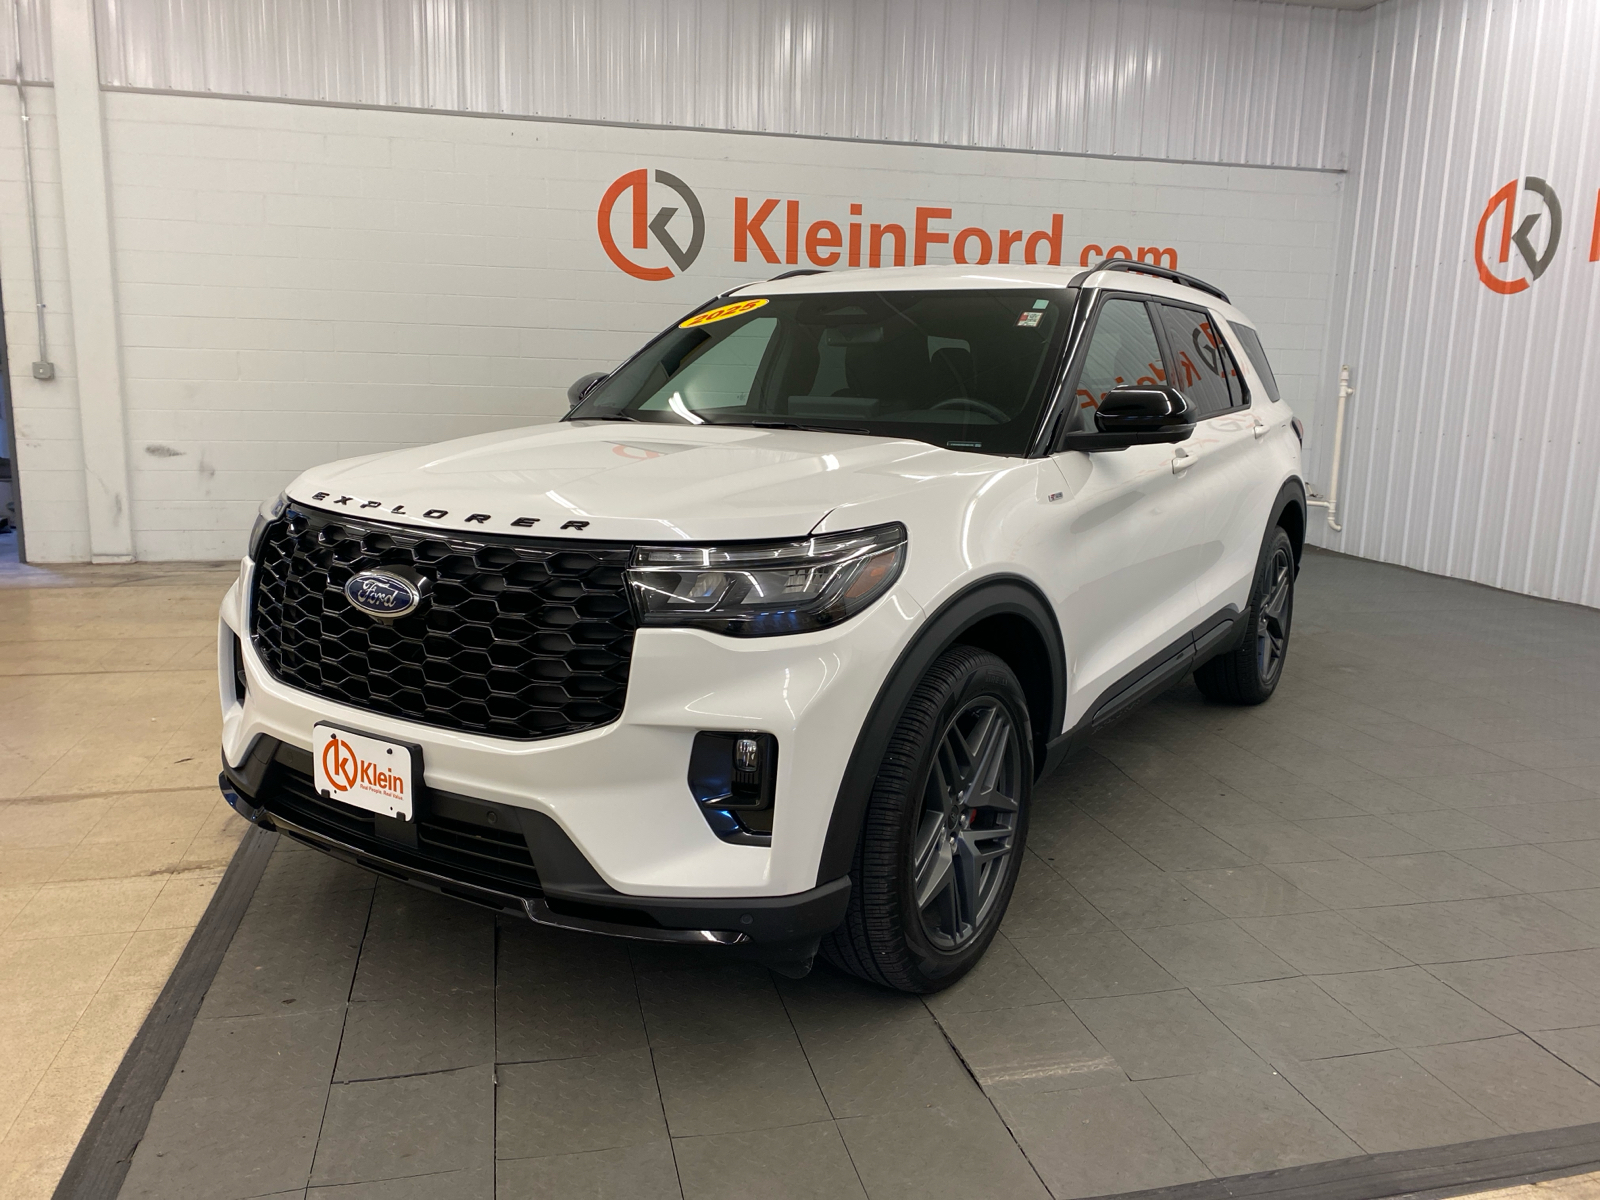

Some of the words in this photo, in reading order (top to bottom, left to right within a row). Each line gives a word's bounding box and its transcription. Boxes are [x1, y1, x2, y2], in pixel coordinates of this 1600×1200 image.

[734, 196, 1178, 278] KleinFordcom
[686, 300, 760, 326] 2025
[312, 491, 590, 531] EXPLORER
[357, 579, 397, 608] Ford
[360, 760, 404, 794] Klein
